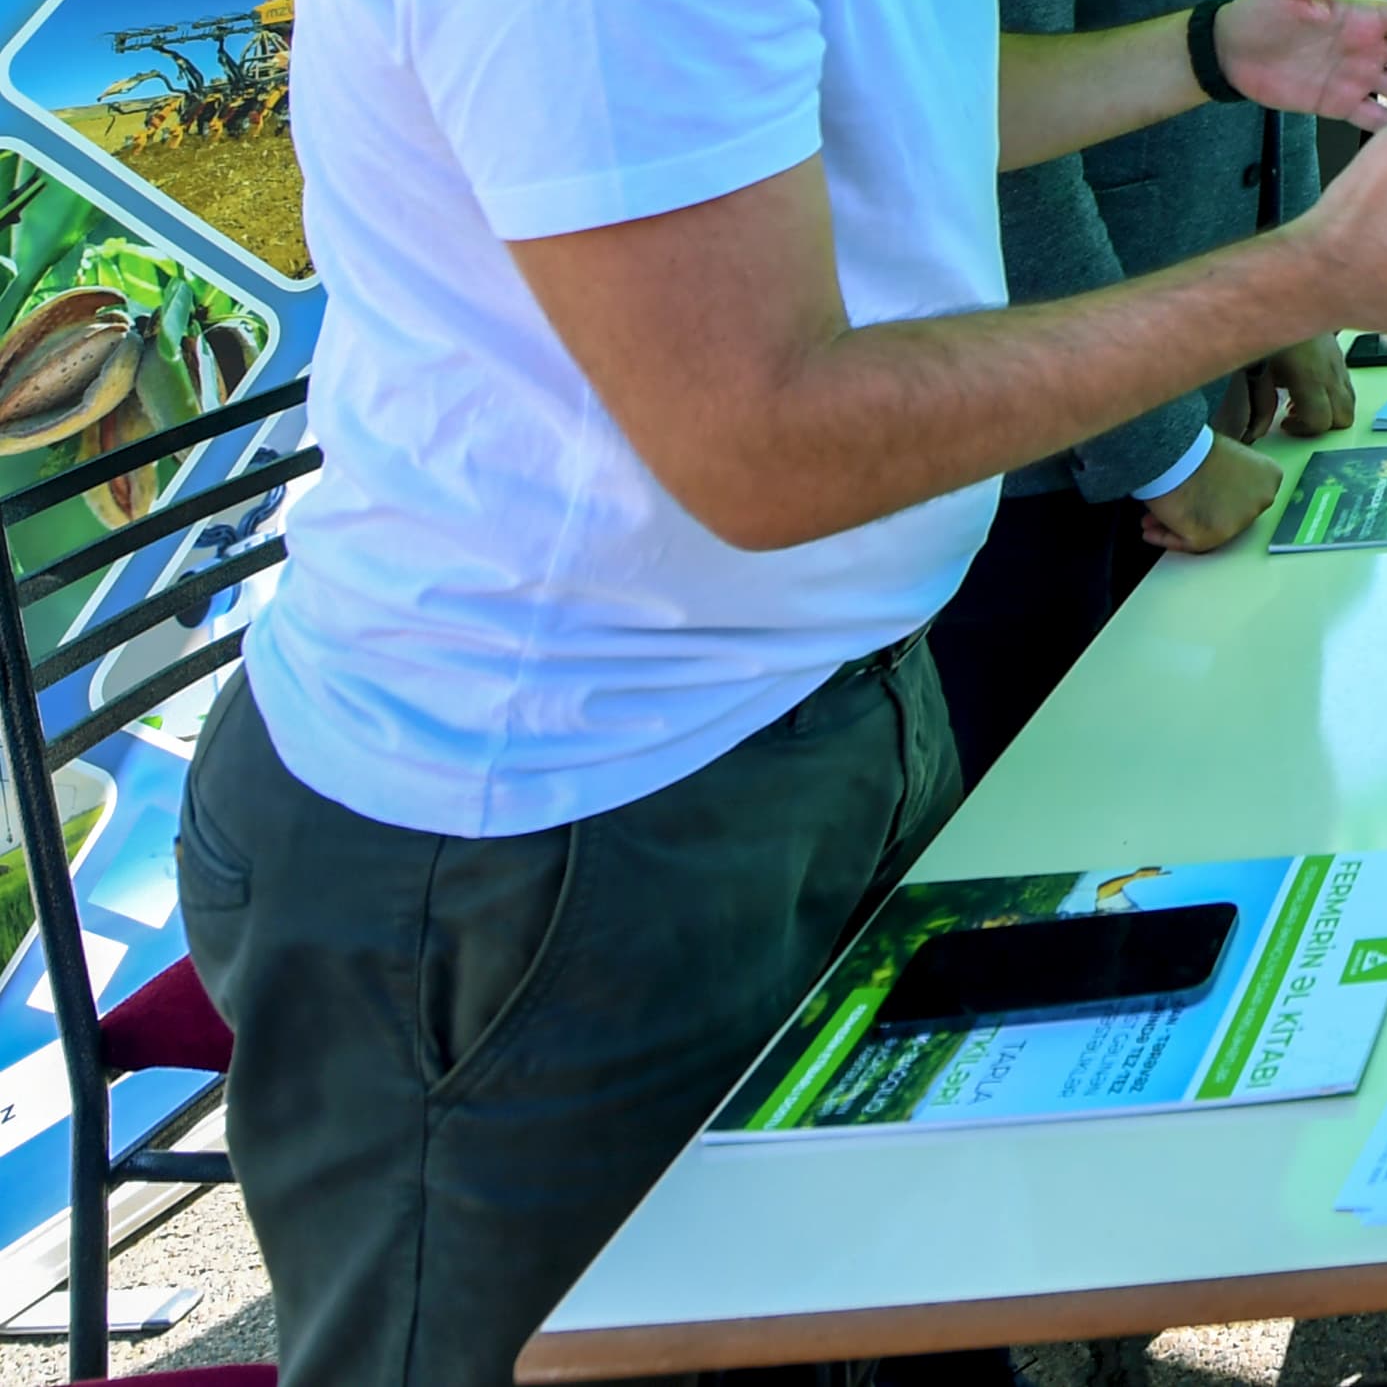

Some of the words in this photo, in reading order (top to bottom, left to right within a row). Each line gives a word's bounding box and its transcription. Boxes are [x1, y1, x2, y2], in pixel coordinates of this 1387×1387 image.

[1299, 861, 1363, 968] FERMERİN
[1283, 976, 1316, 1006] ƏL
[1246, 1012, 1304, 1089] KİTABI
